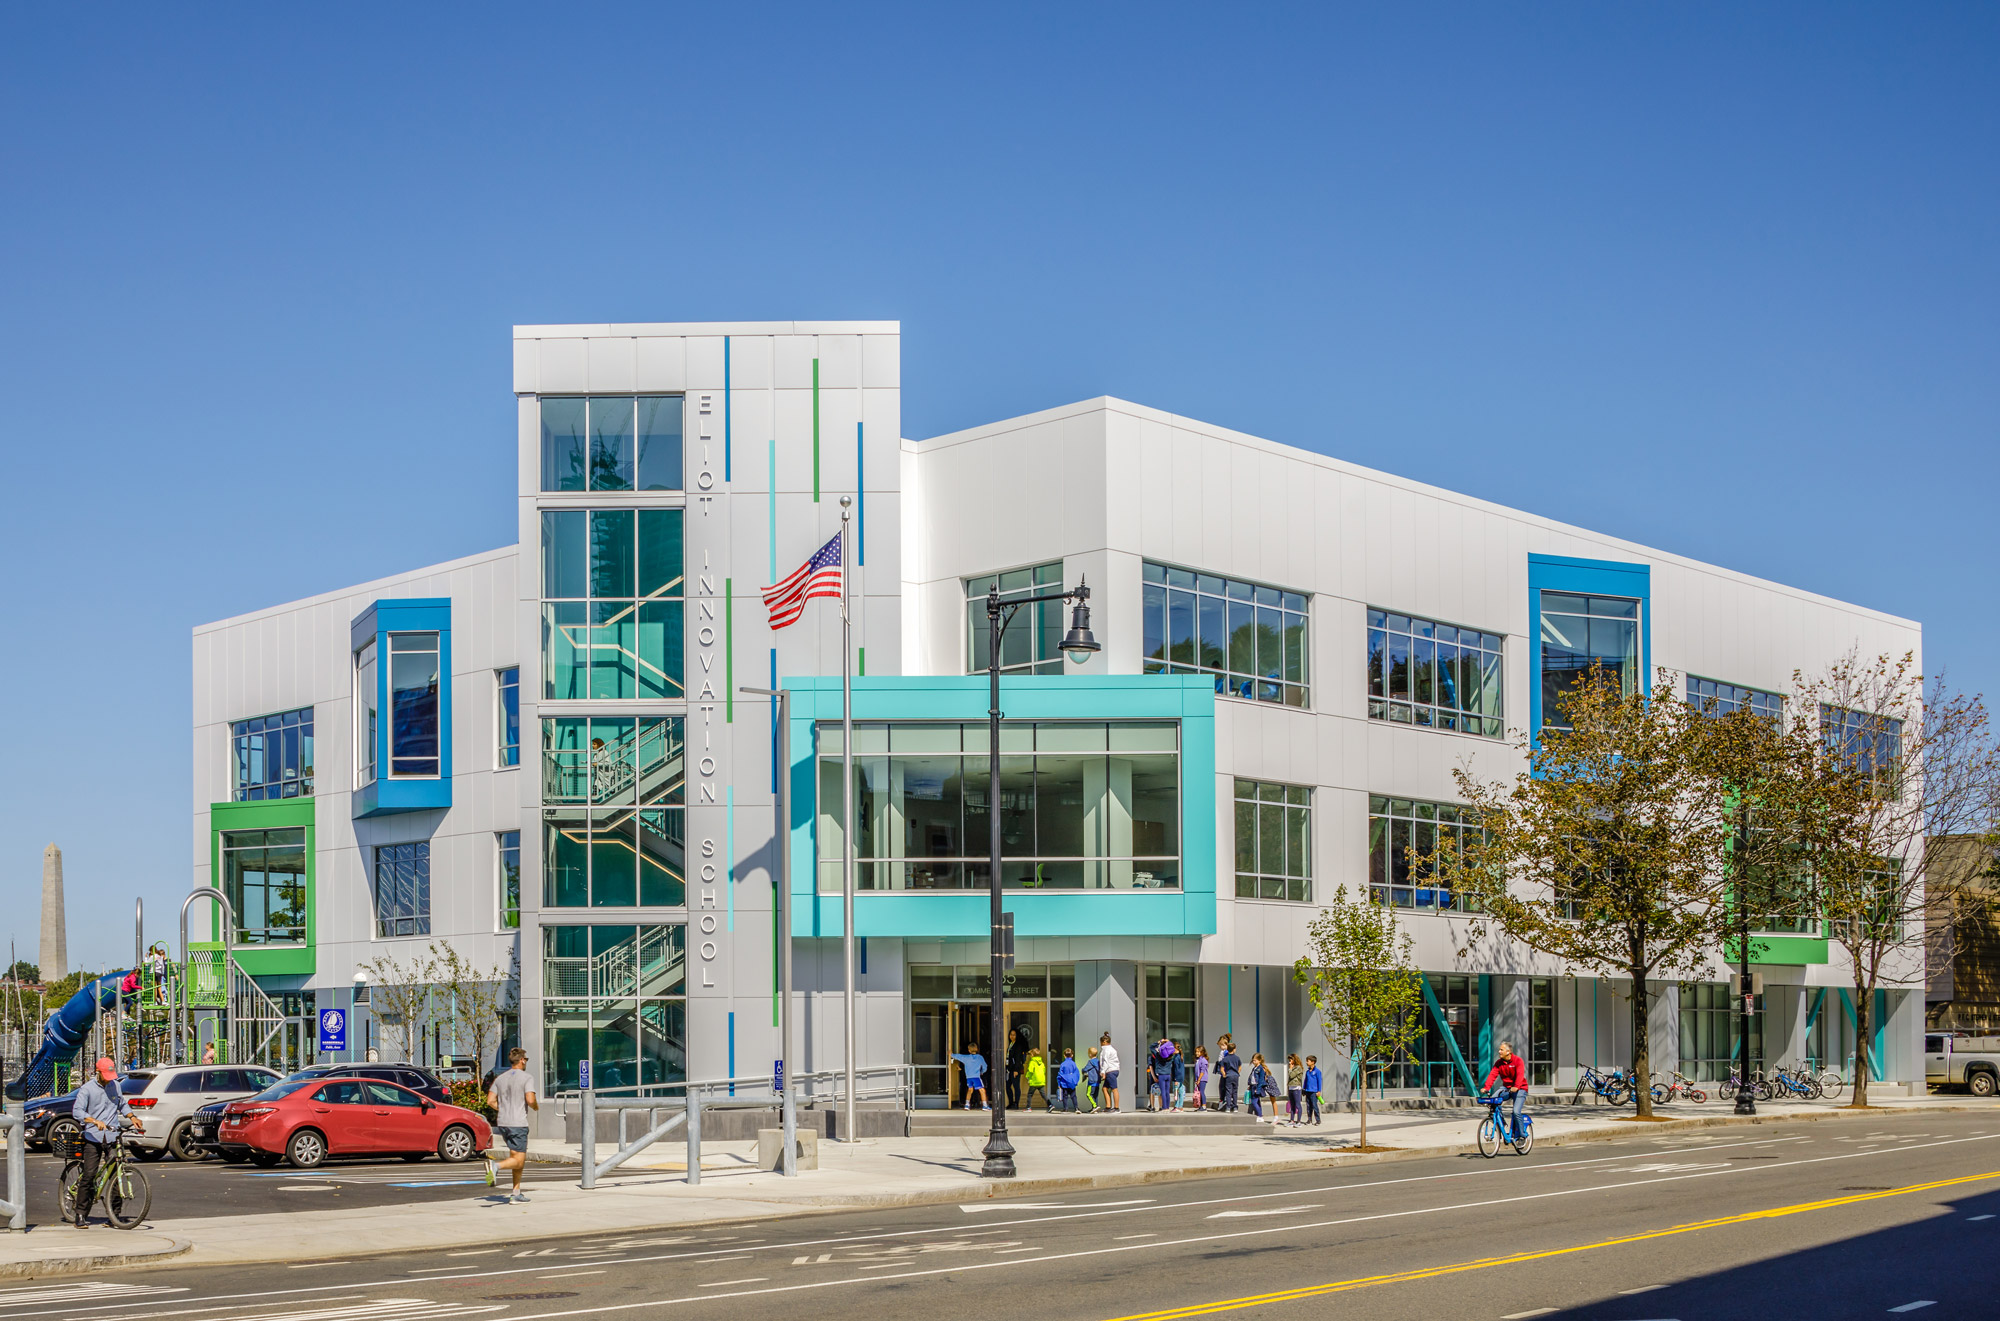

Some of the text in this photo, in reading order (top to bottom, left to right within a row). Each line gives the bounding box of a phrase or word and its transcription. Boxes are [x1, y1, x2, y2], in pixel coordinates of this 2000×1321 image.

[698, 395, 717, 988] ELIOT INNOVATION SCHOOL
